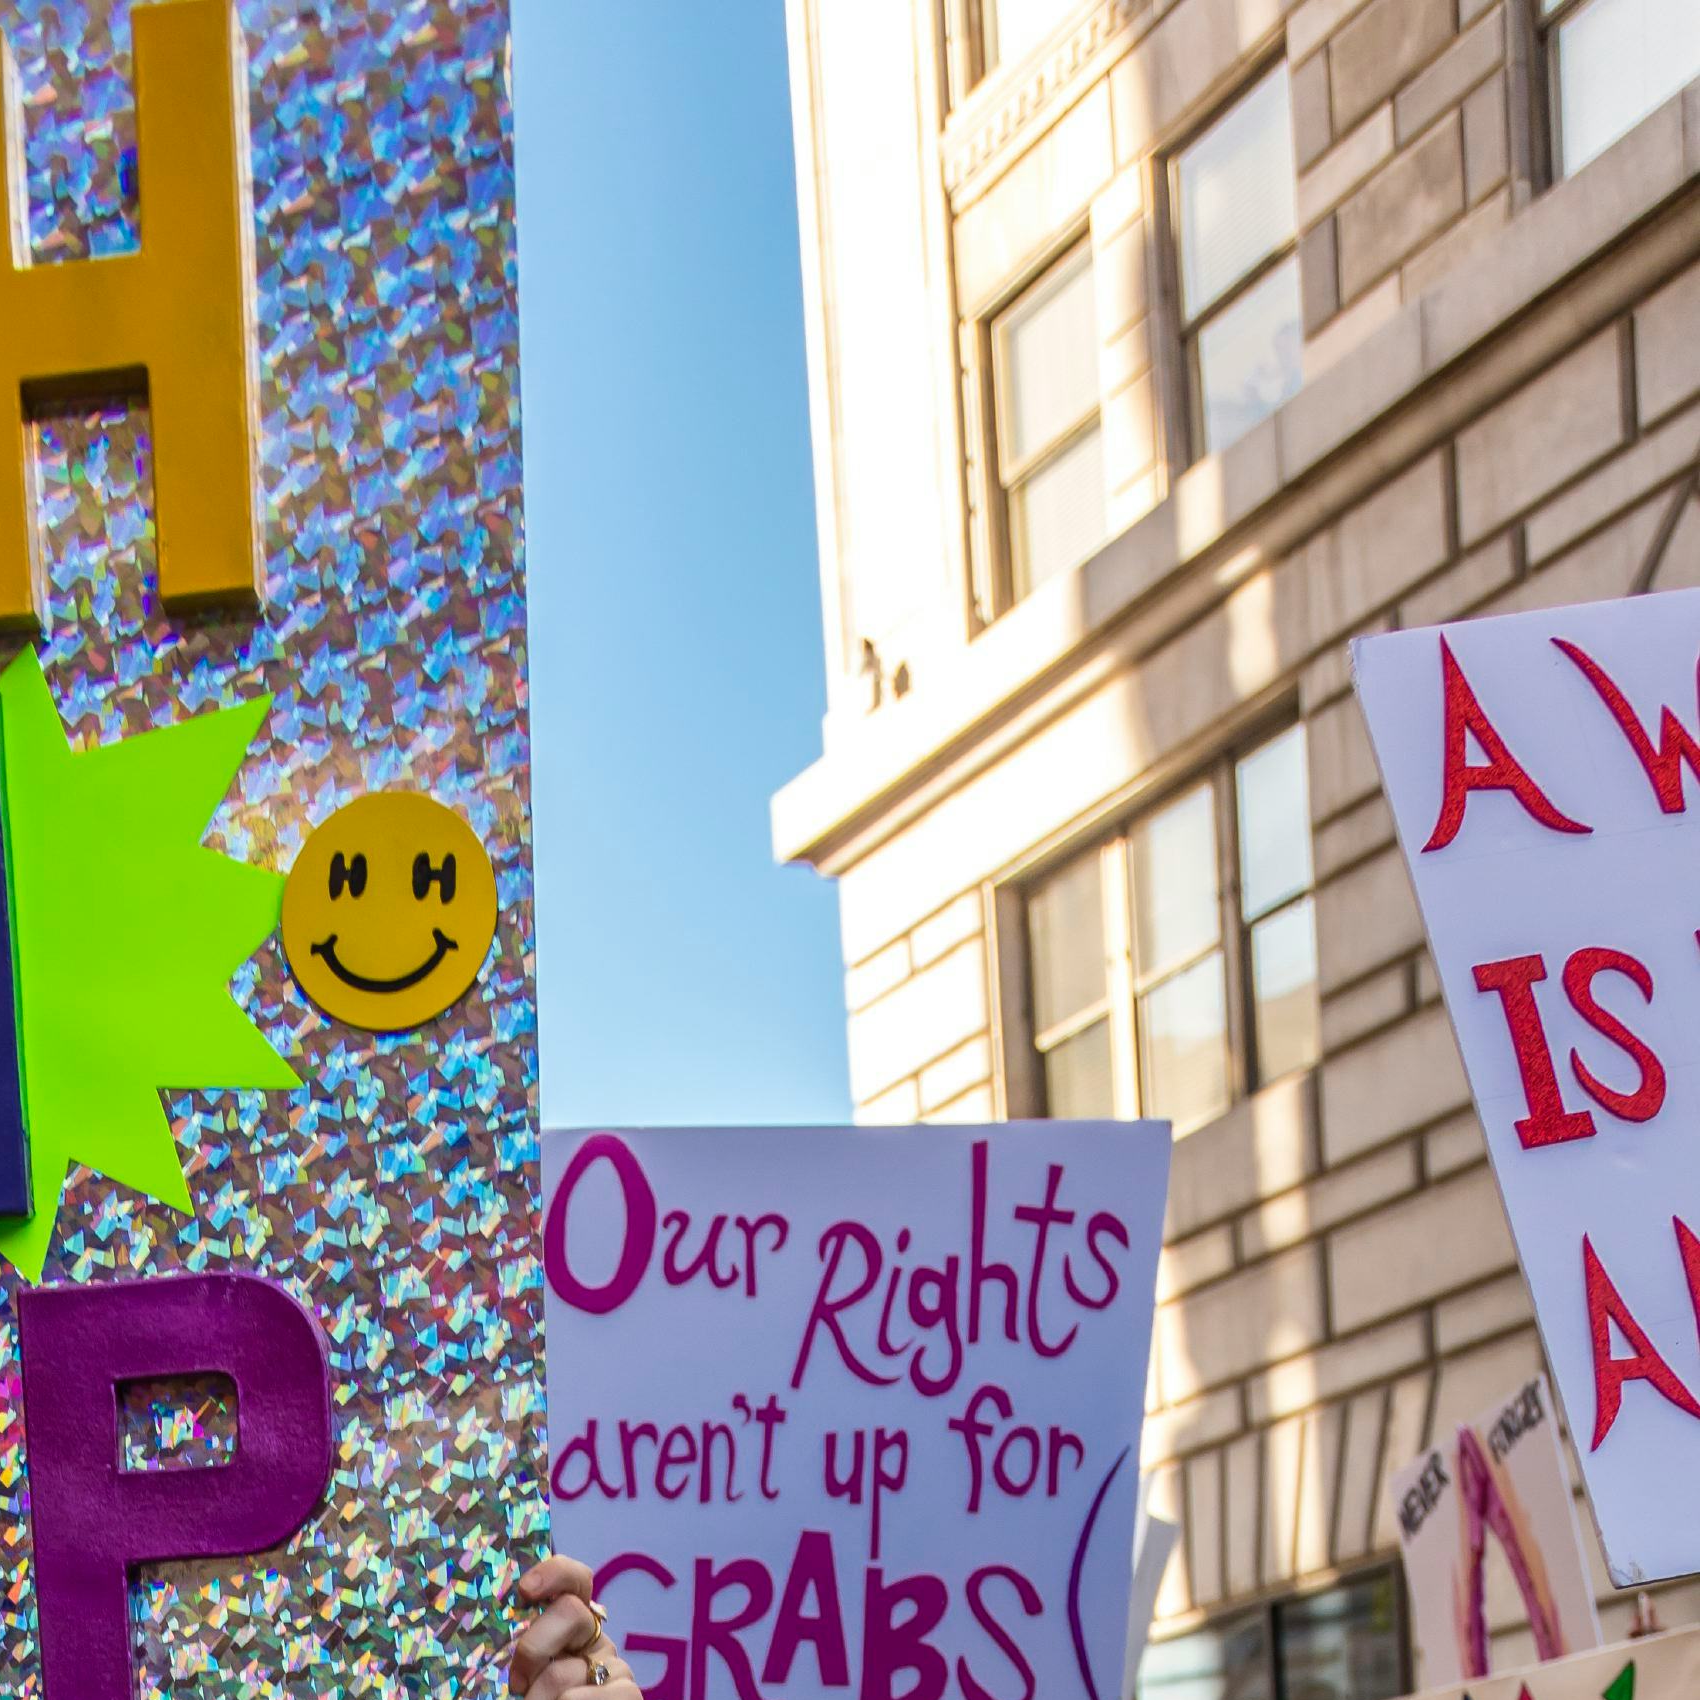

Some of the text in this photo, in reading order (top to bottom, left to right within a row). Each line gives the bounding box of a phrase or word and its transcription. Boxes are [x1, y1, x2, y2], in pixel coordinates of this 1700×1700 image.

[1421, 631, 1594, 853] A
[1472, 947, 1667, 1150] IS
[542, 1133, 1131, 1396] Our Rights
[550, 1384, 1085, 1560] aren't up for
